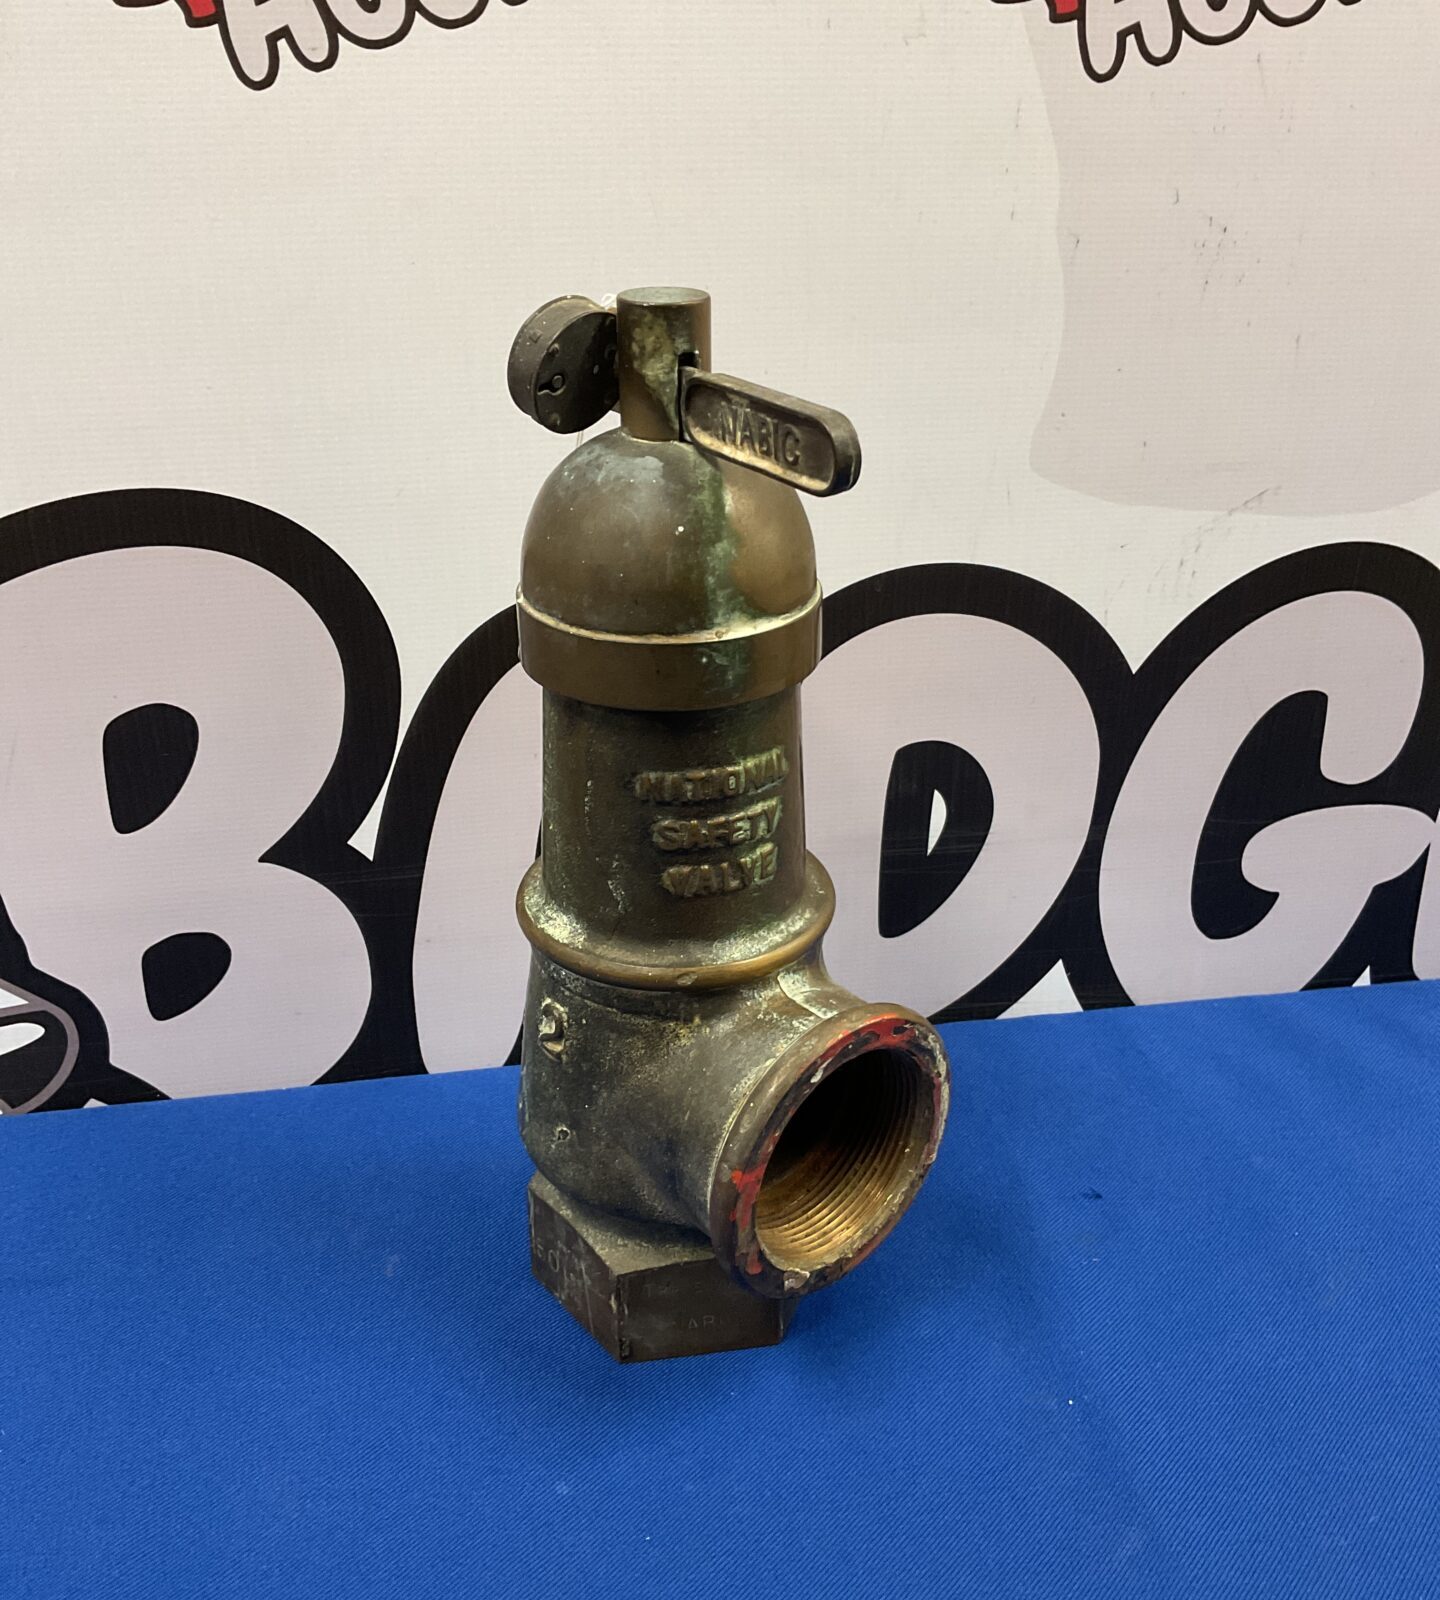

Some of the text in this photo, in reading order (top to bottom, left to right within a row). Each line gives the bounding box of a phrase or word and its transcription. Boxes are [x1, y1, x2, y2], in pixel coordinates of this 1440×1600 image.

[715, 397, 804, 468] NABIC
[633, 746, 790, 804] NATIONAL
[651, 797, 782, 850] SAFETY
[660, 842, 778, 897] VALVE
